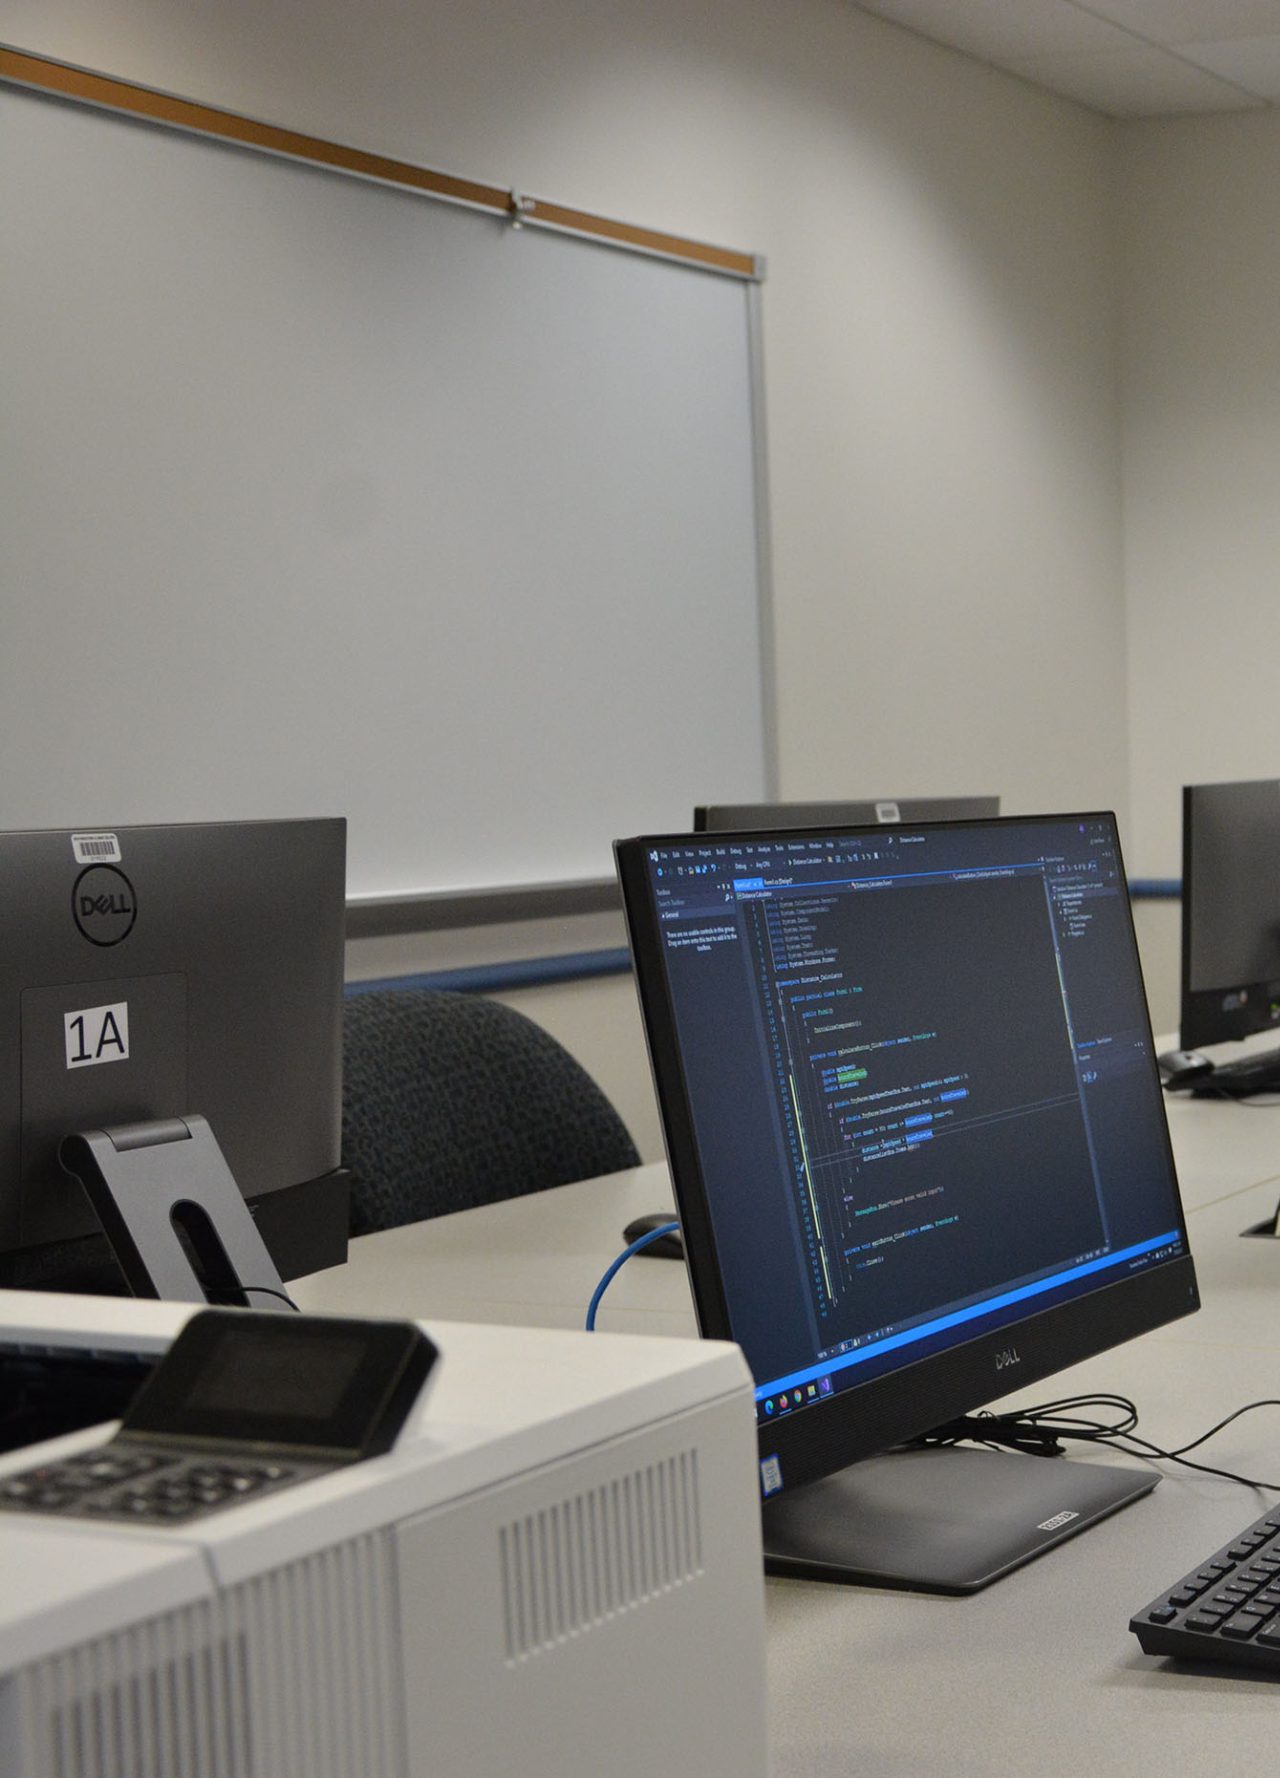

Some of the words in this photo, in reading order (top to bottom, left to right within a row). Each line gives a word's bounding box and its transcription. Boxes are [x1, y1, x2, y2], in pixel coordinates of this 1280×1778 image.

[80, 894, 131, 916] DELL
[70, 1011, 124, 1062] 1A
[996, 1347, 1020, 1370] DELL
